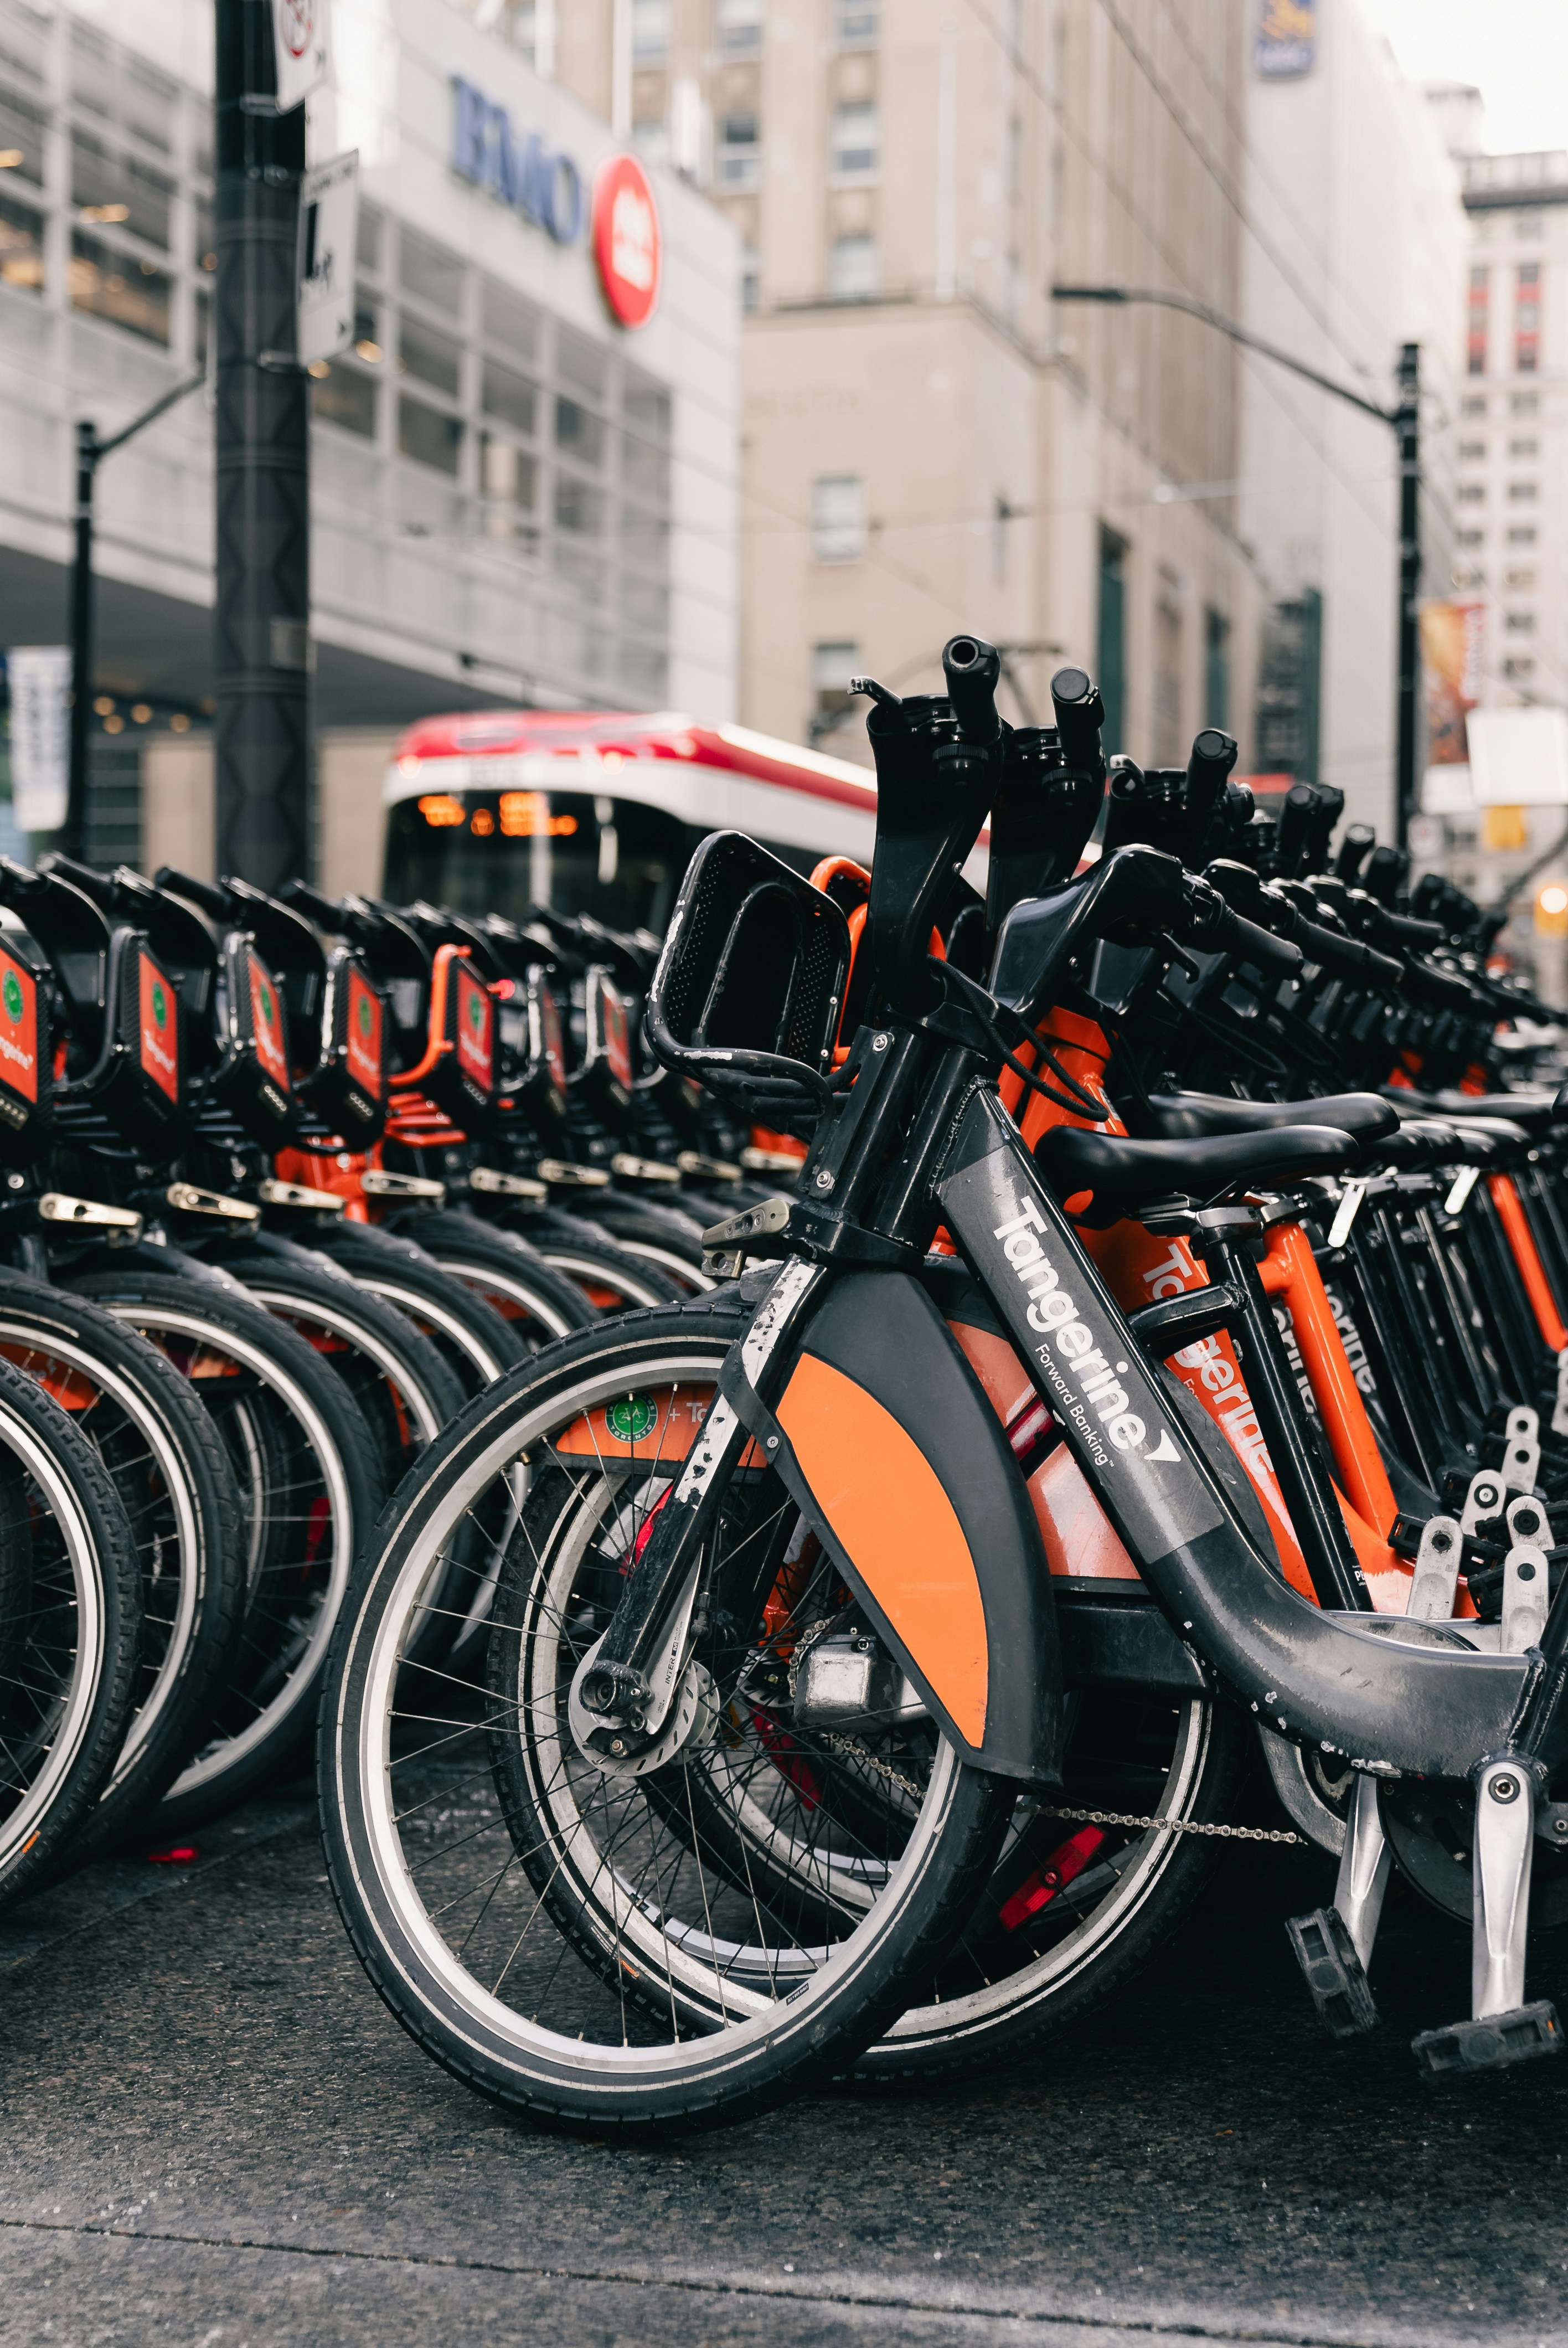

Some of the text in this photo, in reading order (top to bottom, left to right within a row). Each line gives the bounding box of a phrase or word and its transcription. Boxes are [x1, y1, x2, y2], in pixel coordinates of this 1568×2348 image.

[993, 1196, 1146, 1449] Tangerine
[1035, 1343, 1077, 1405] Forward
[665, 1657, 675, 1685] INTER
